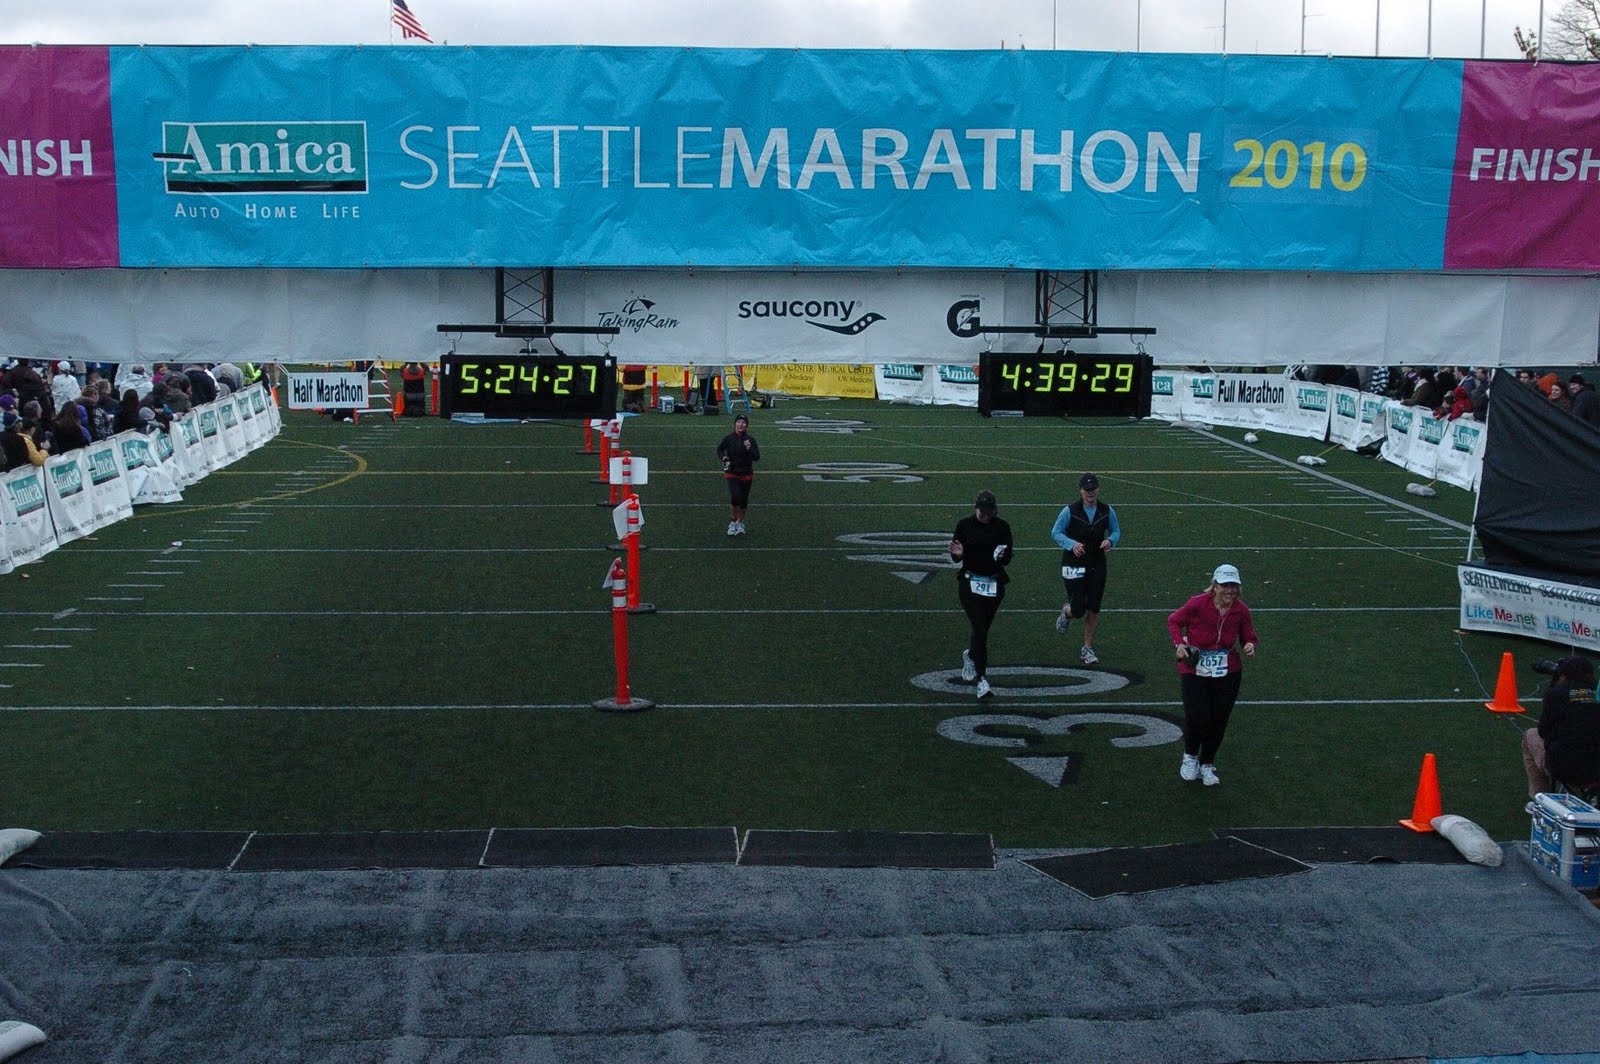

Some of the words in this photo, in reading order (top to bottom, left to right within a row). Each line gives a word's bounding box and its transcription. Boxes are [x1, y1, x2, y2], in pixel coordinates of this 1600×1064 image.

[171, 125, 356, 175] Amica
[1229, 139, 1368, 191] 2010
[1469, 147, 1600, 182] FINISH
[174, 203, 220, 219] AUTO
[245, 203, 298, 219] HOME
[322, 203, 361, 218] LIFE
[738, 300, 855, 322] saucony
[293, 379, 313, 403] Half
[316, 379, 363, 403] Marathon
[1218, 380, 1235, 403] Full
[1238, 380, 1284, 404] Marathon
[976, 582, 990, 593] 291
[1466, 604, 1537, 626] LikeMe.net
[1199, 656, 1223, 667] 2657
